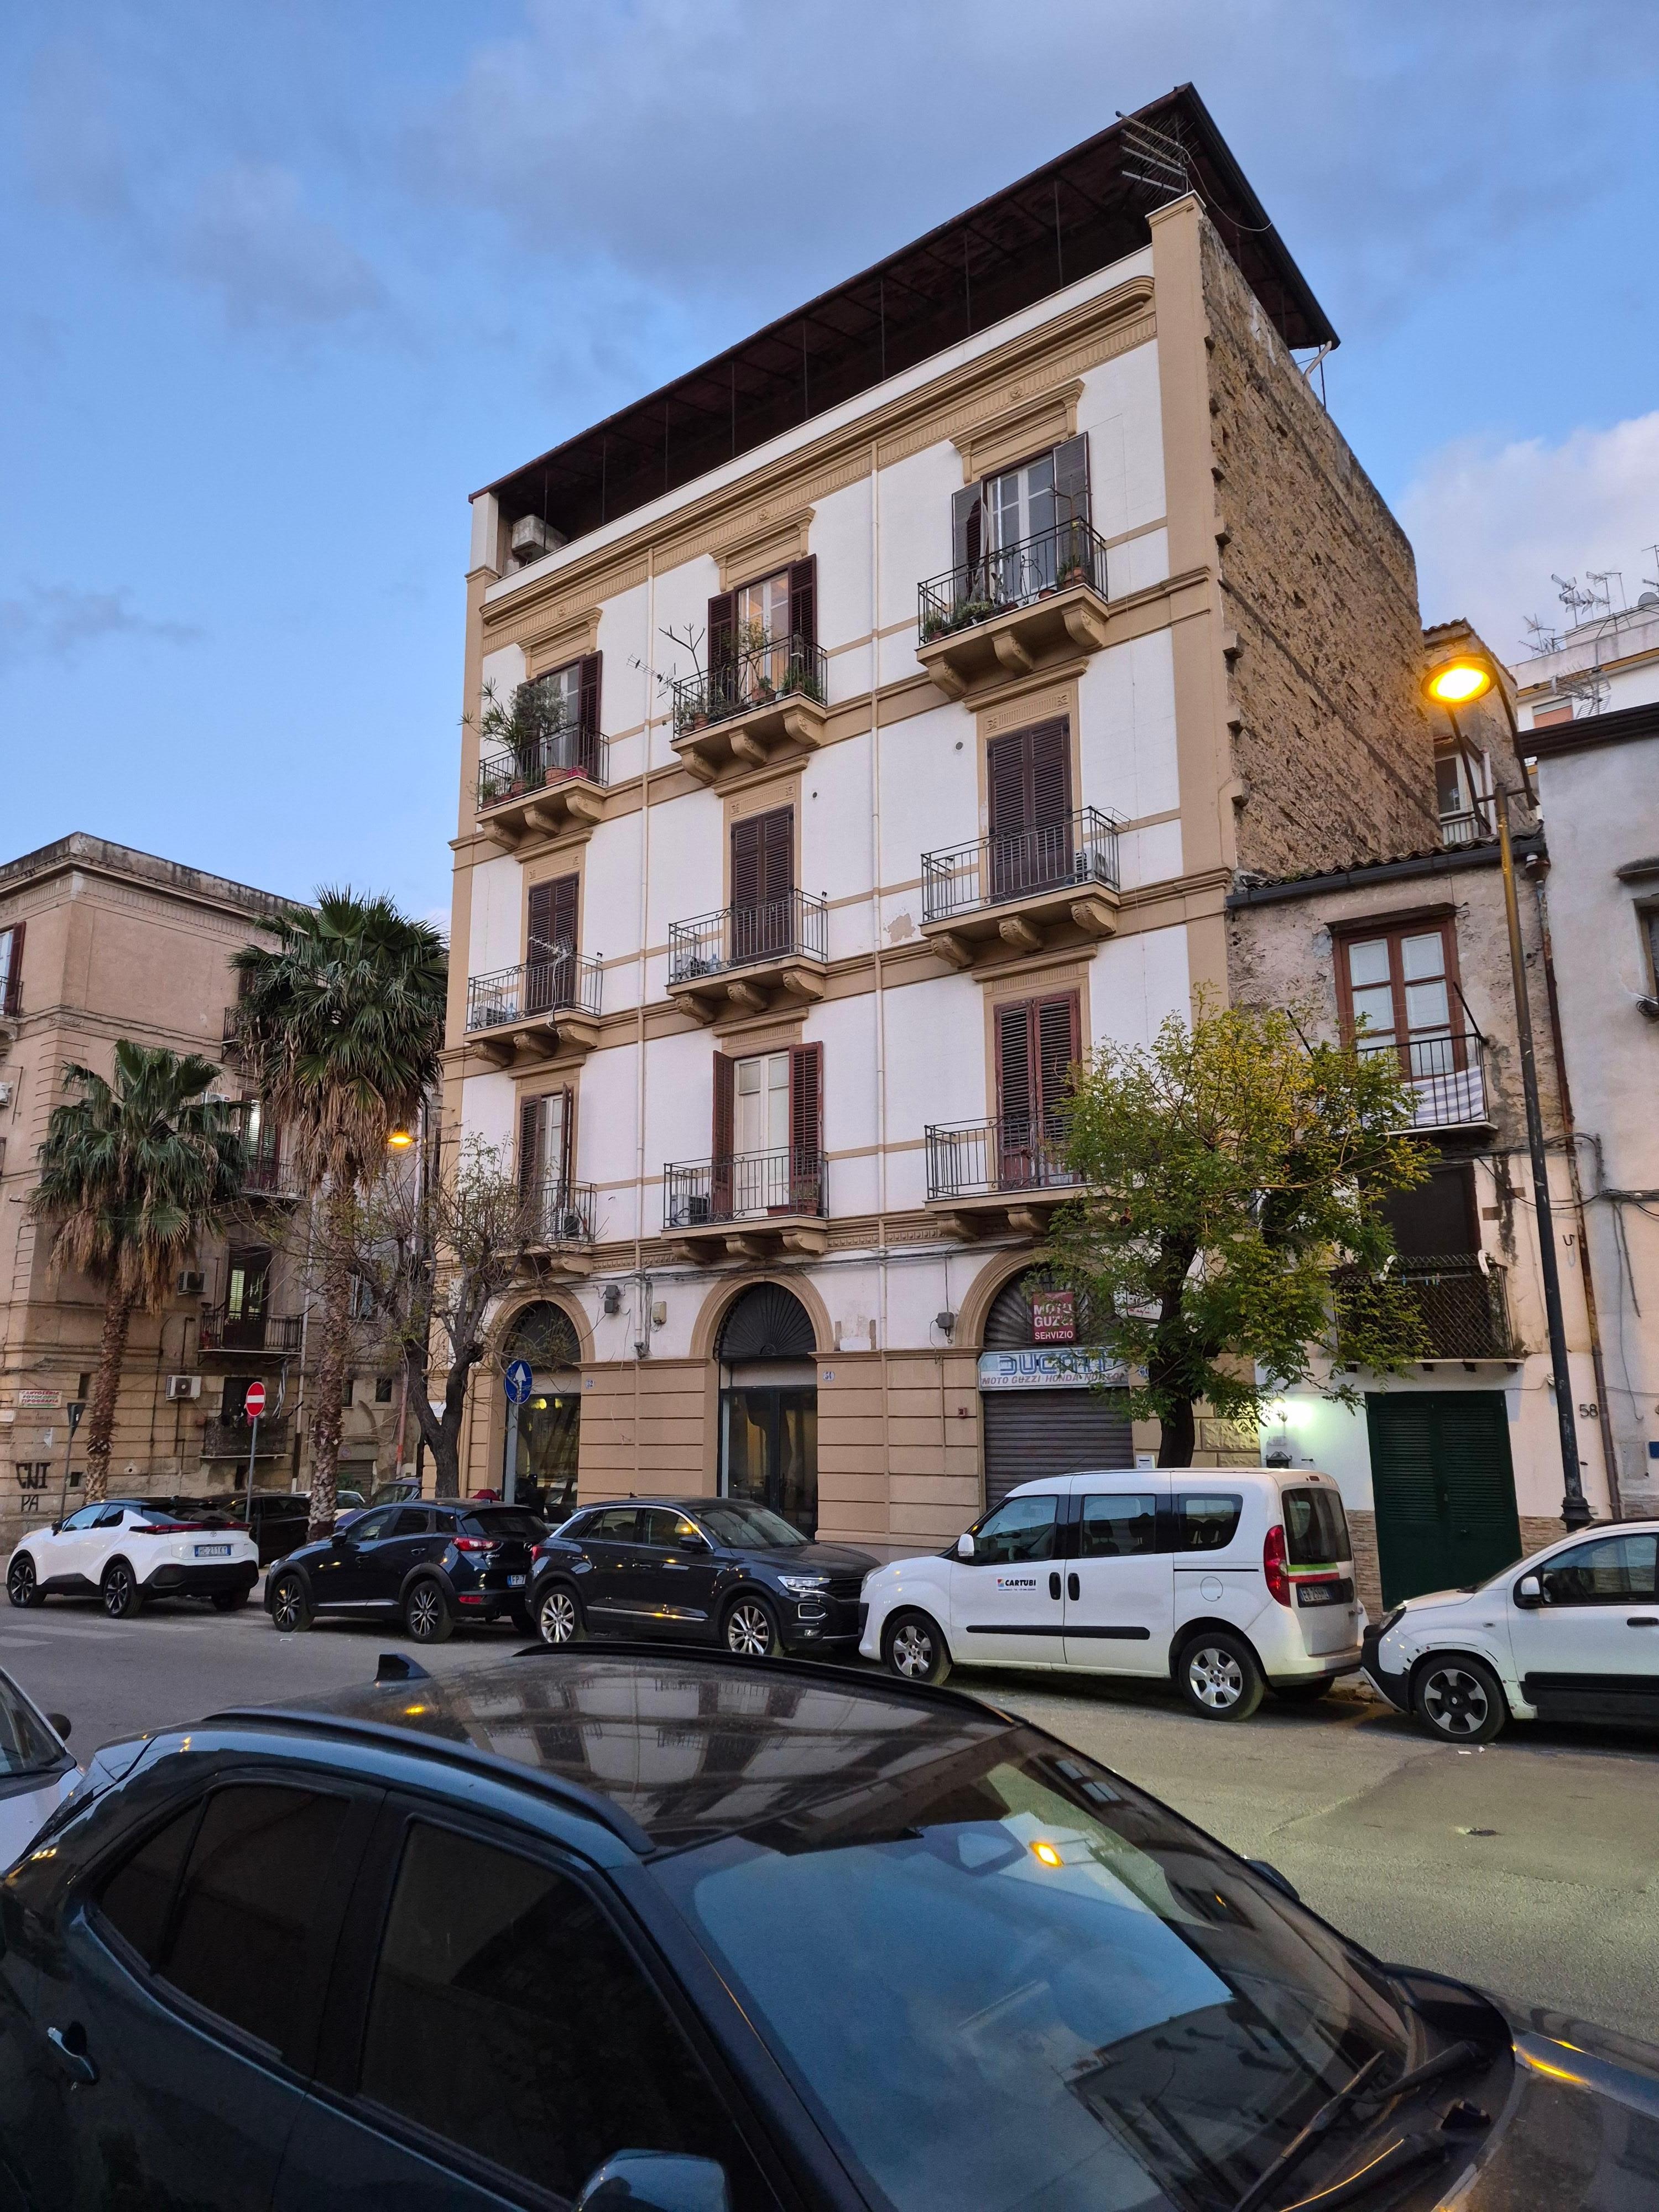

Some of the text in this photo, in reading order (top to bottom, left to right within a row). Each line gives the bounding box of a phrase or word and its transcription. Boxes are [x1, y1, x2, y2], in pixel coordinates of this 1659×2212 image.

[1035, 1331, 1073, 1339] SERVIZIO
[1011, 1375, 1041, 1384] GUZZI
[1046, 1374, 1078, 1382] HONDA
[1579, 1404, 1599, 1417] 58
